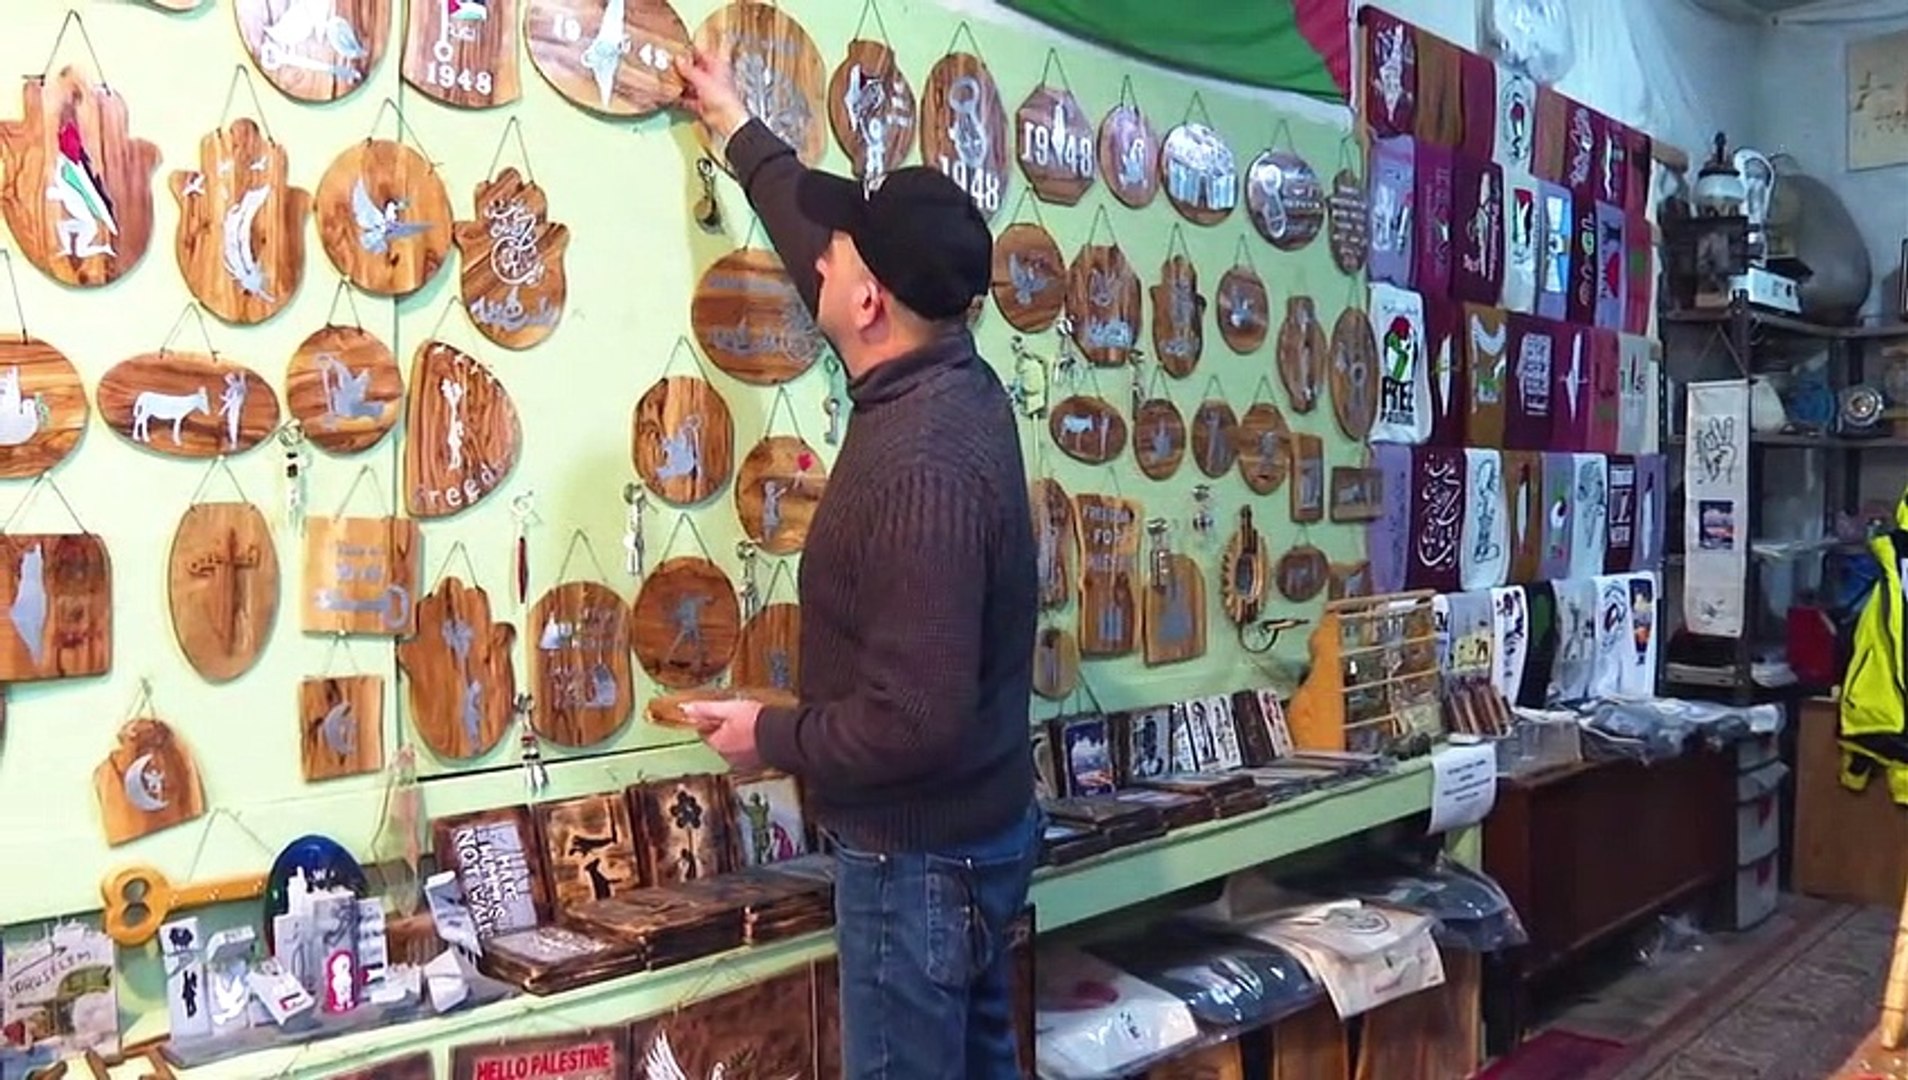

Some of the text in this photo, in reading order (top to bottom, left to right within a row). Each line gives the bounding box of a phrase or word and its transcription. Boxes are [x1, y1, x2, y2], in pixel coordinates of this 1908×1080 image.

[426, 61, 493, 96] 1948
[455, 827, 482, 880] NOT
[476, 1044, 611, 1080] HELLO PALESTINE
